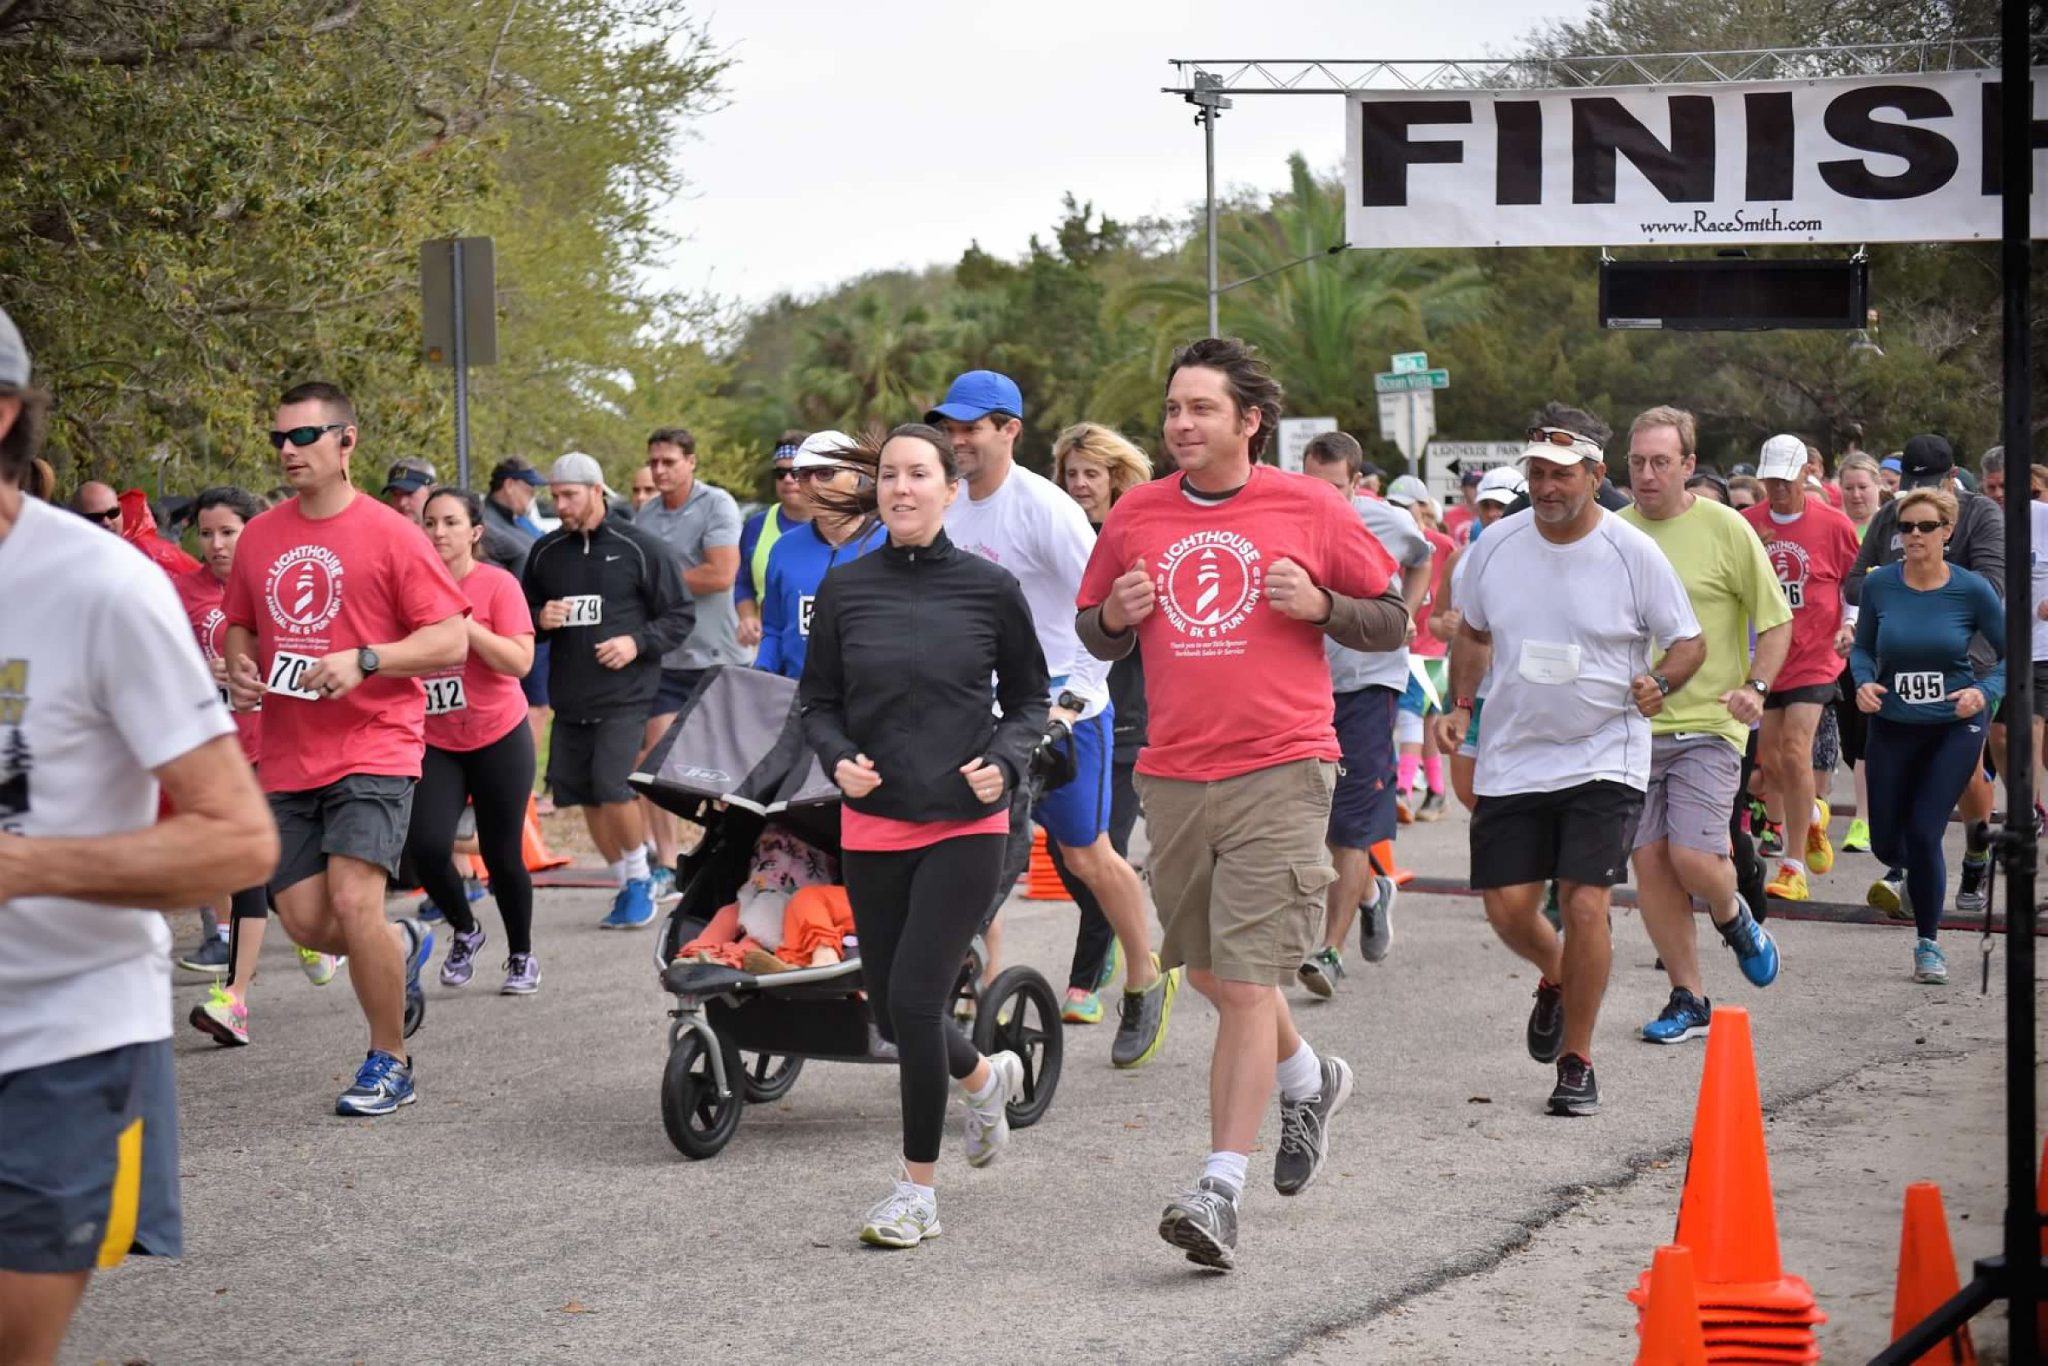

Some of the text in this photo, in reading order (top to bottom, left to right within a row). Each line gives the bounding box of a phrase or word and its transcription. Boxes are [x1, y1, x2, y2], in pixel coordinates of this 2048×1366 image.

[1640, 208, 1822, 233] www.RaceSmith.com
[267, 544, 344, 579] LIGHTHOUSE
[1157, 530, 1261, 571] LIGHTHOUSE
[1158, 594, 1187, 634] ANNUAL
[1220, 611, 1246, 635] FUN
[1242, 587, 1261, 615] RUN
[1781, 583, 1801, 606] 6
[271, 655, 317, 694] 70
[1898, 674, 1942, 700] 495
